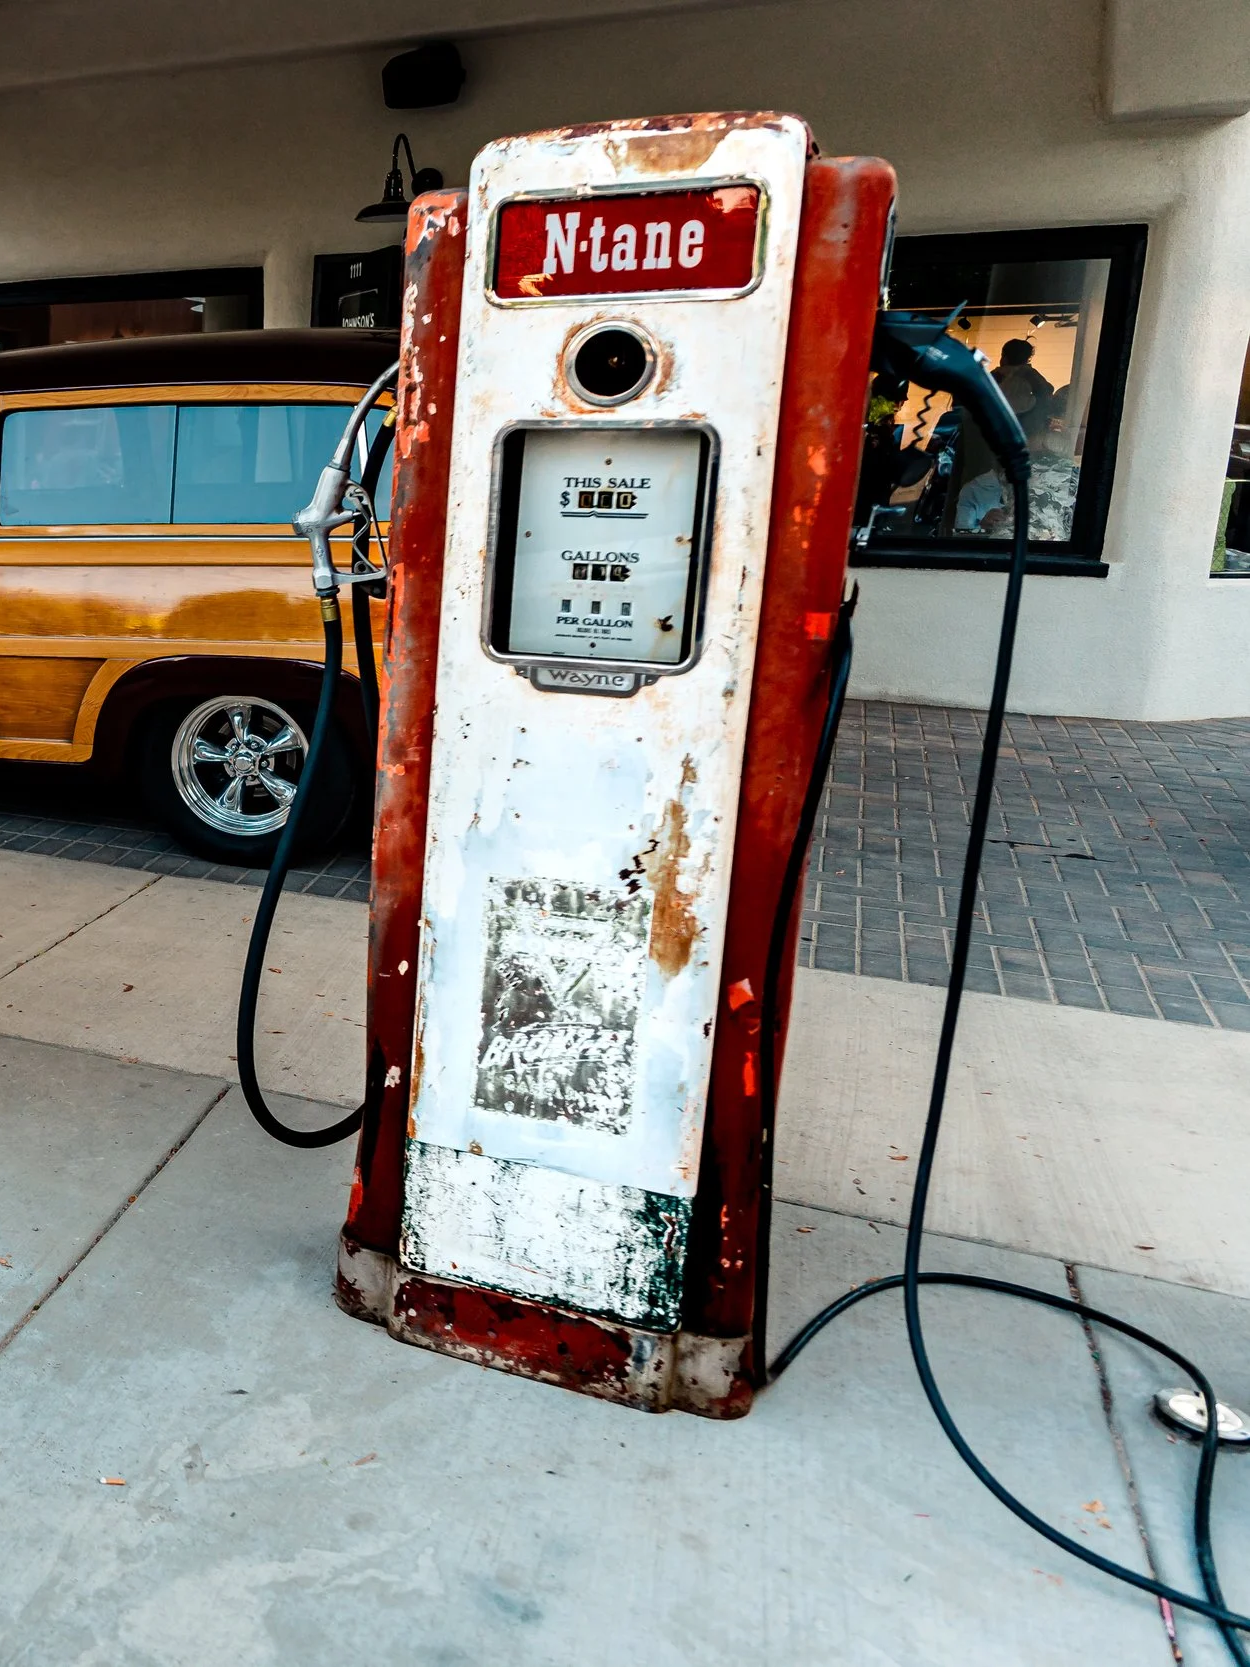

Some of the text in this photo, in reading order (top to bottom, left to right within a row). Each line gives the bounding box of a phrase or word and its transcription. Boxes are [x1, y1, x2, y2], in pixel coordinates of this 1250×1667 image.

[563, 477, 651, 489] THIS SALE
[560, 550, 640, 564] GALLONS
[556, 616, 633, 628] PER GALLON
[548, 669, 625, 686] Wayne
